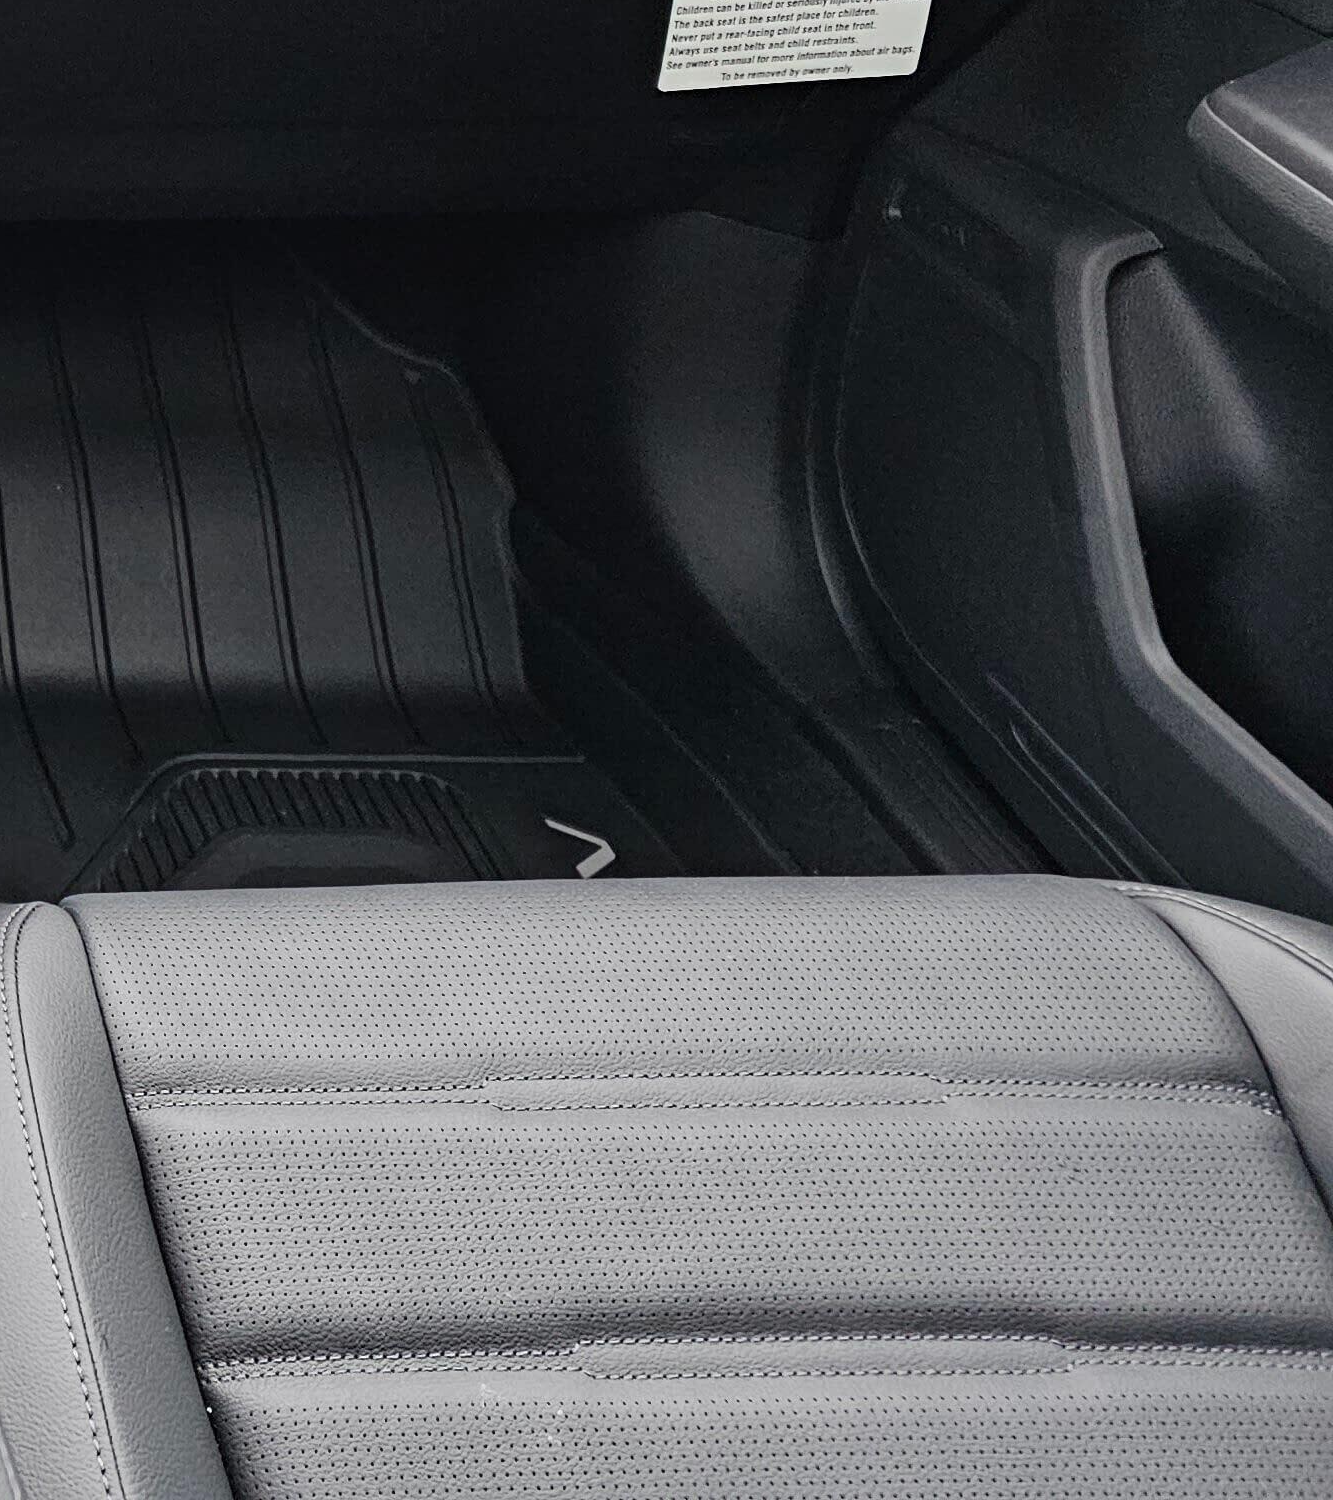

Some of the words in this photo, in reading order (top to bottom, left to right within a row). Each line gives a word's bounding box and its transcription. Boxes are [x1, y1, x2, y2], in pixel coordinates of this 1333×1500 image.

[674, 20, 690, 29] The
[693, 18, 713, 28] back
[716, 17, 736, 26] seat
[738, 16, 746, 25] is
[749, 15, 763, 24] the
[766, 12, 794, 22] safest
[796, 12, 820, 22] place
[823, 10, 835, 19] for
[838, 8, 879, 18] children.
[676, 5, 713, 15] Children
[716, 4, 732, 13] can
[734, 3, 745, 11] be
[748, 1, 773, 10] killed
[672, 34, 698, 42] Never
[700, 32, 715, 41] put
[717, 32, 723, 40] a
[725, 28, 775, 39] rear-facing
[777, 26, 800, 35] child
[802, 24, 822, 34] seat
[824, 23, 833, 32] in
[835, 22, 850, 31] the
[852, 21, 876, 30] front.
[669, 47, 700, 57] Always
[703, 46, 719, 54] use
[722, 43, 742, 53] seat
[744, 42, 765, 51] belts
[768, 41, 785, 49] and
[788, 38, 810, 48] child
[812, 36, 859, 46] restraints.
[666, 61, 683, 70] See
[685, 59, 719, 69] owner's
[721, 56, 755, 66] manual
[757, 55, 770, 63] for
[771, 54, 795, 62] more
[796, 50, 848, 60] information
[850, 47, 875, 57] about
[877, 46, 890, 55] air
[721, 72, 731, 81] To
[733, 71, 745, 80] be
[747, 68, 787, 79] removed
[789, 68, 799, 77] by
[802, 67, 831, 76] owner
